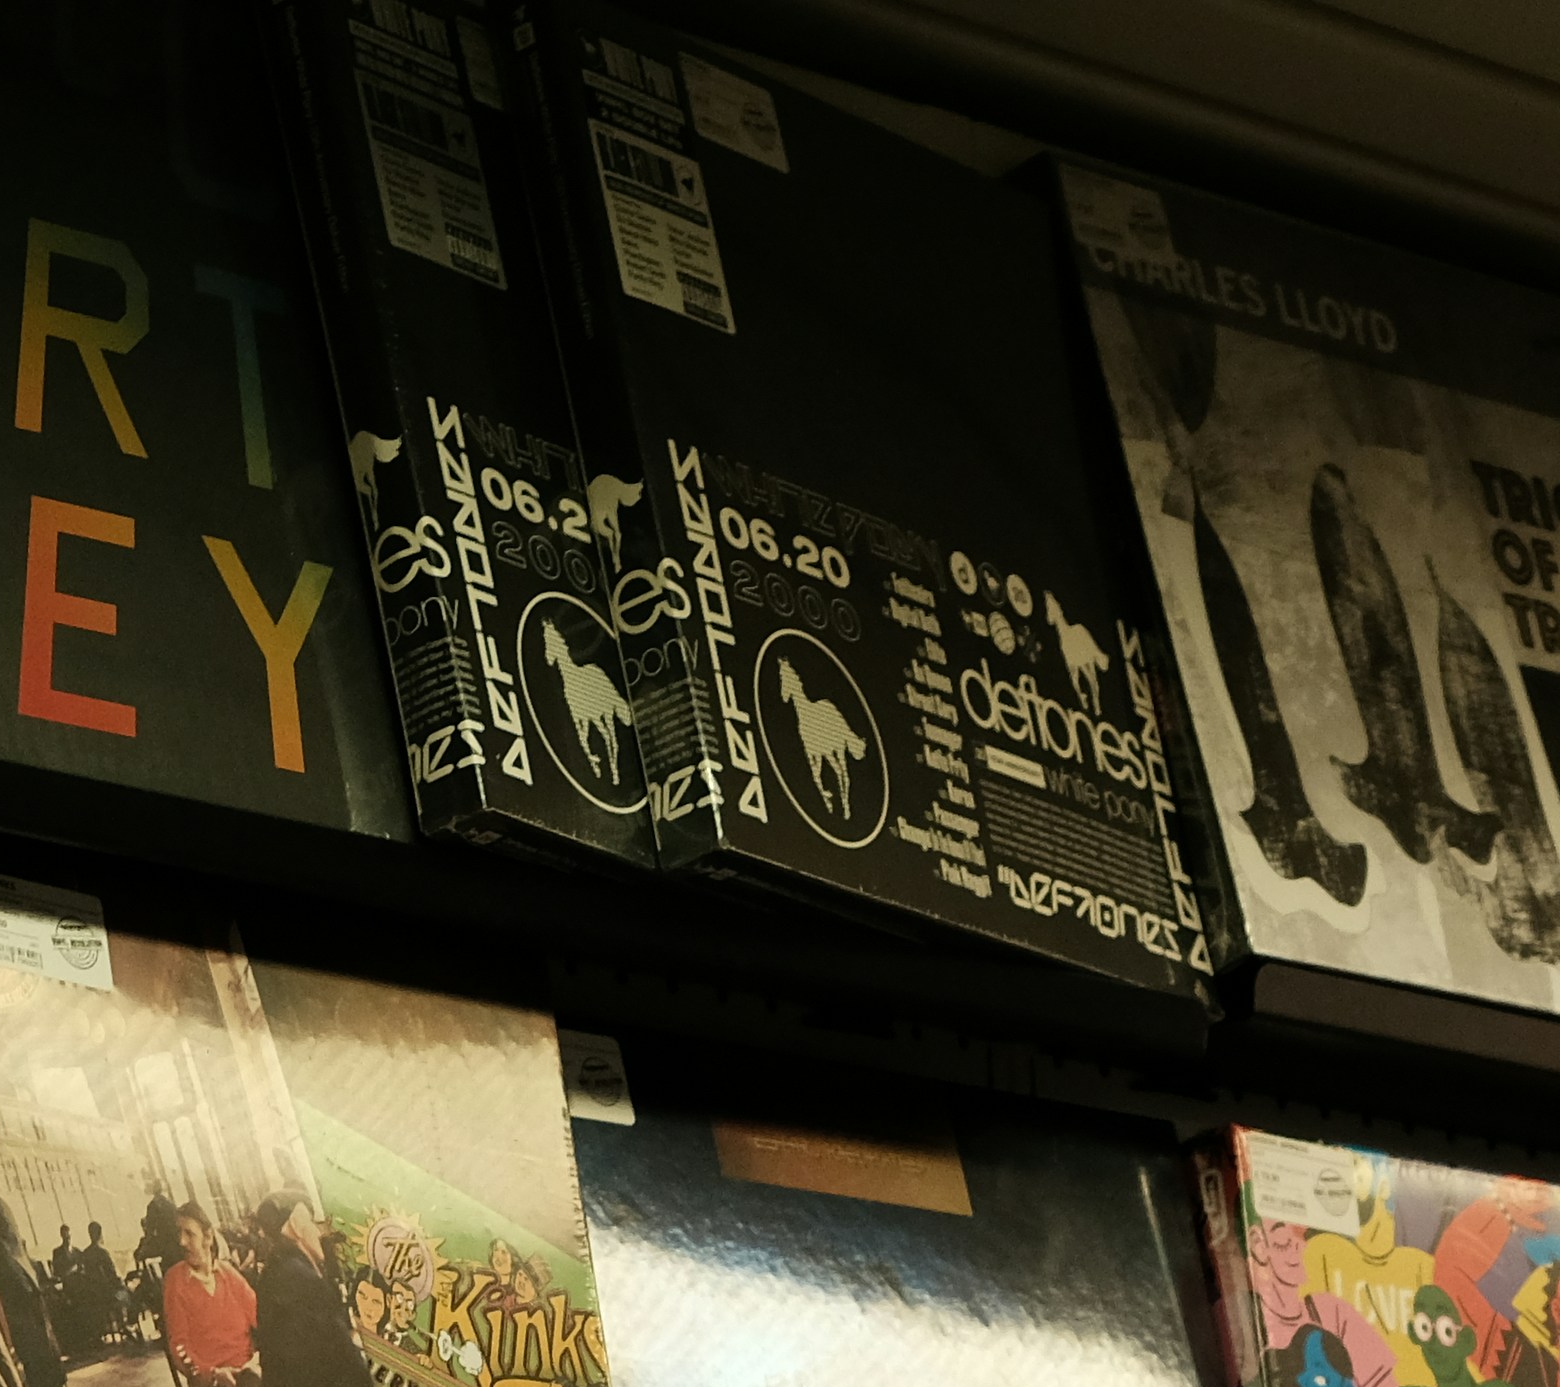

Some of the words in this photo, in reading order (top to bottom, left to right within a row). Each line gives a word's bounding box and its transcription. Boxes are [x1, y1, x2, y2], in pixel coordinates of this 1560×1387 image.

[1089, 243, 1266, 317] CHARLES
[1277, 284, 1398, 354] LLOYD
[480, 467, 595, 544] 06.2
[492, 521, 598, 595] 200
[717, 507, 851, 589] 06.20
[1491, 530, 1559, 592] OF
[729, 560, 861, 643] 2000
[960, 657, 1148, 790] deftones
[382, 1235, 425, 1281] The
